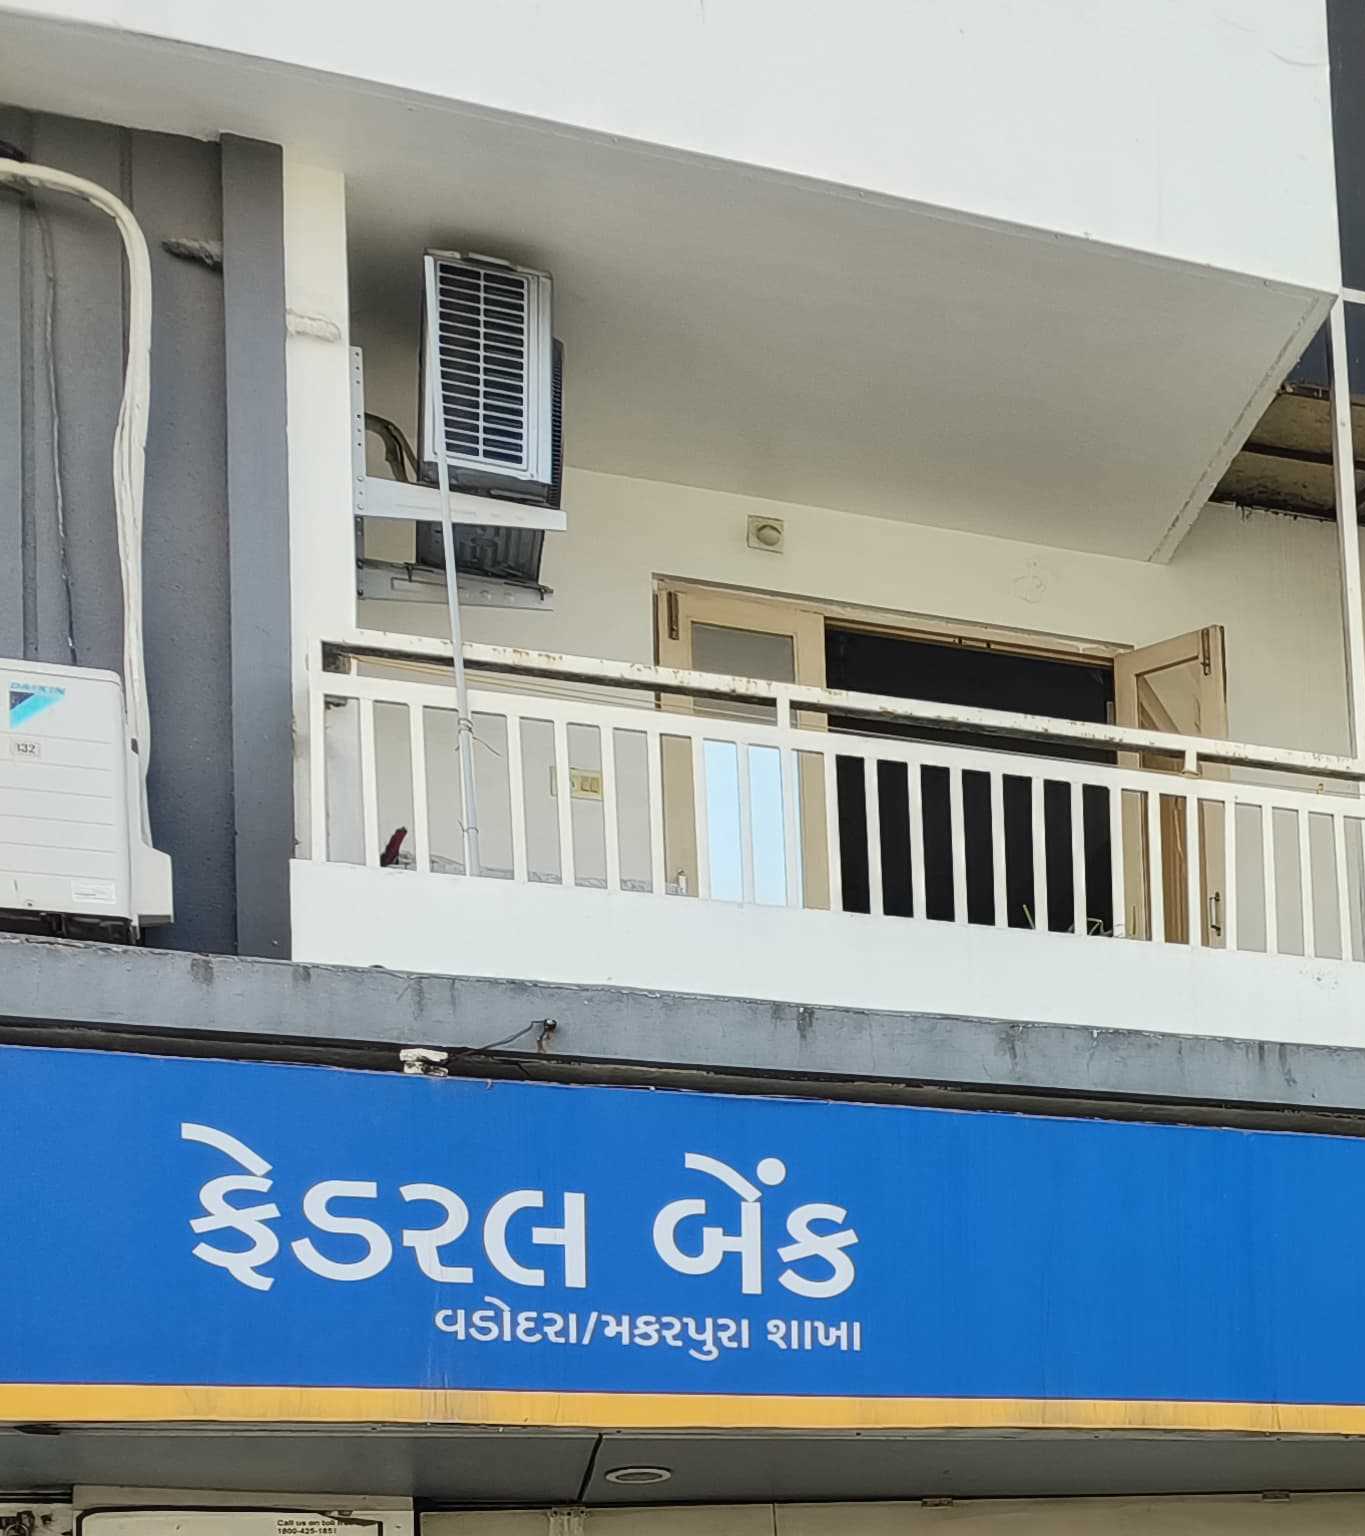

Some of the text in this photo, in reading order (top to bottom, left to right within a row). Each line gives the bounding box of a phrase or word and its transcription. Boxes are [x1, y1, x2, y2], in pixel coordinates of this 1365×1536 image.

[181, 1122, 860, 1299] ફેડરલ બેંક
[433, 1295, 863, 1362] વડોદરા/મકરપુરા શાખા
